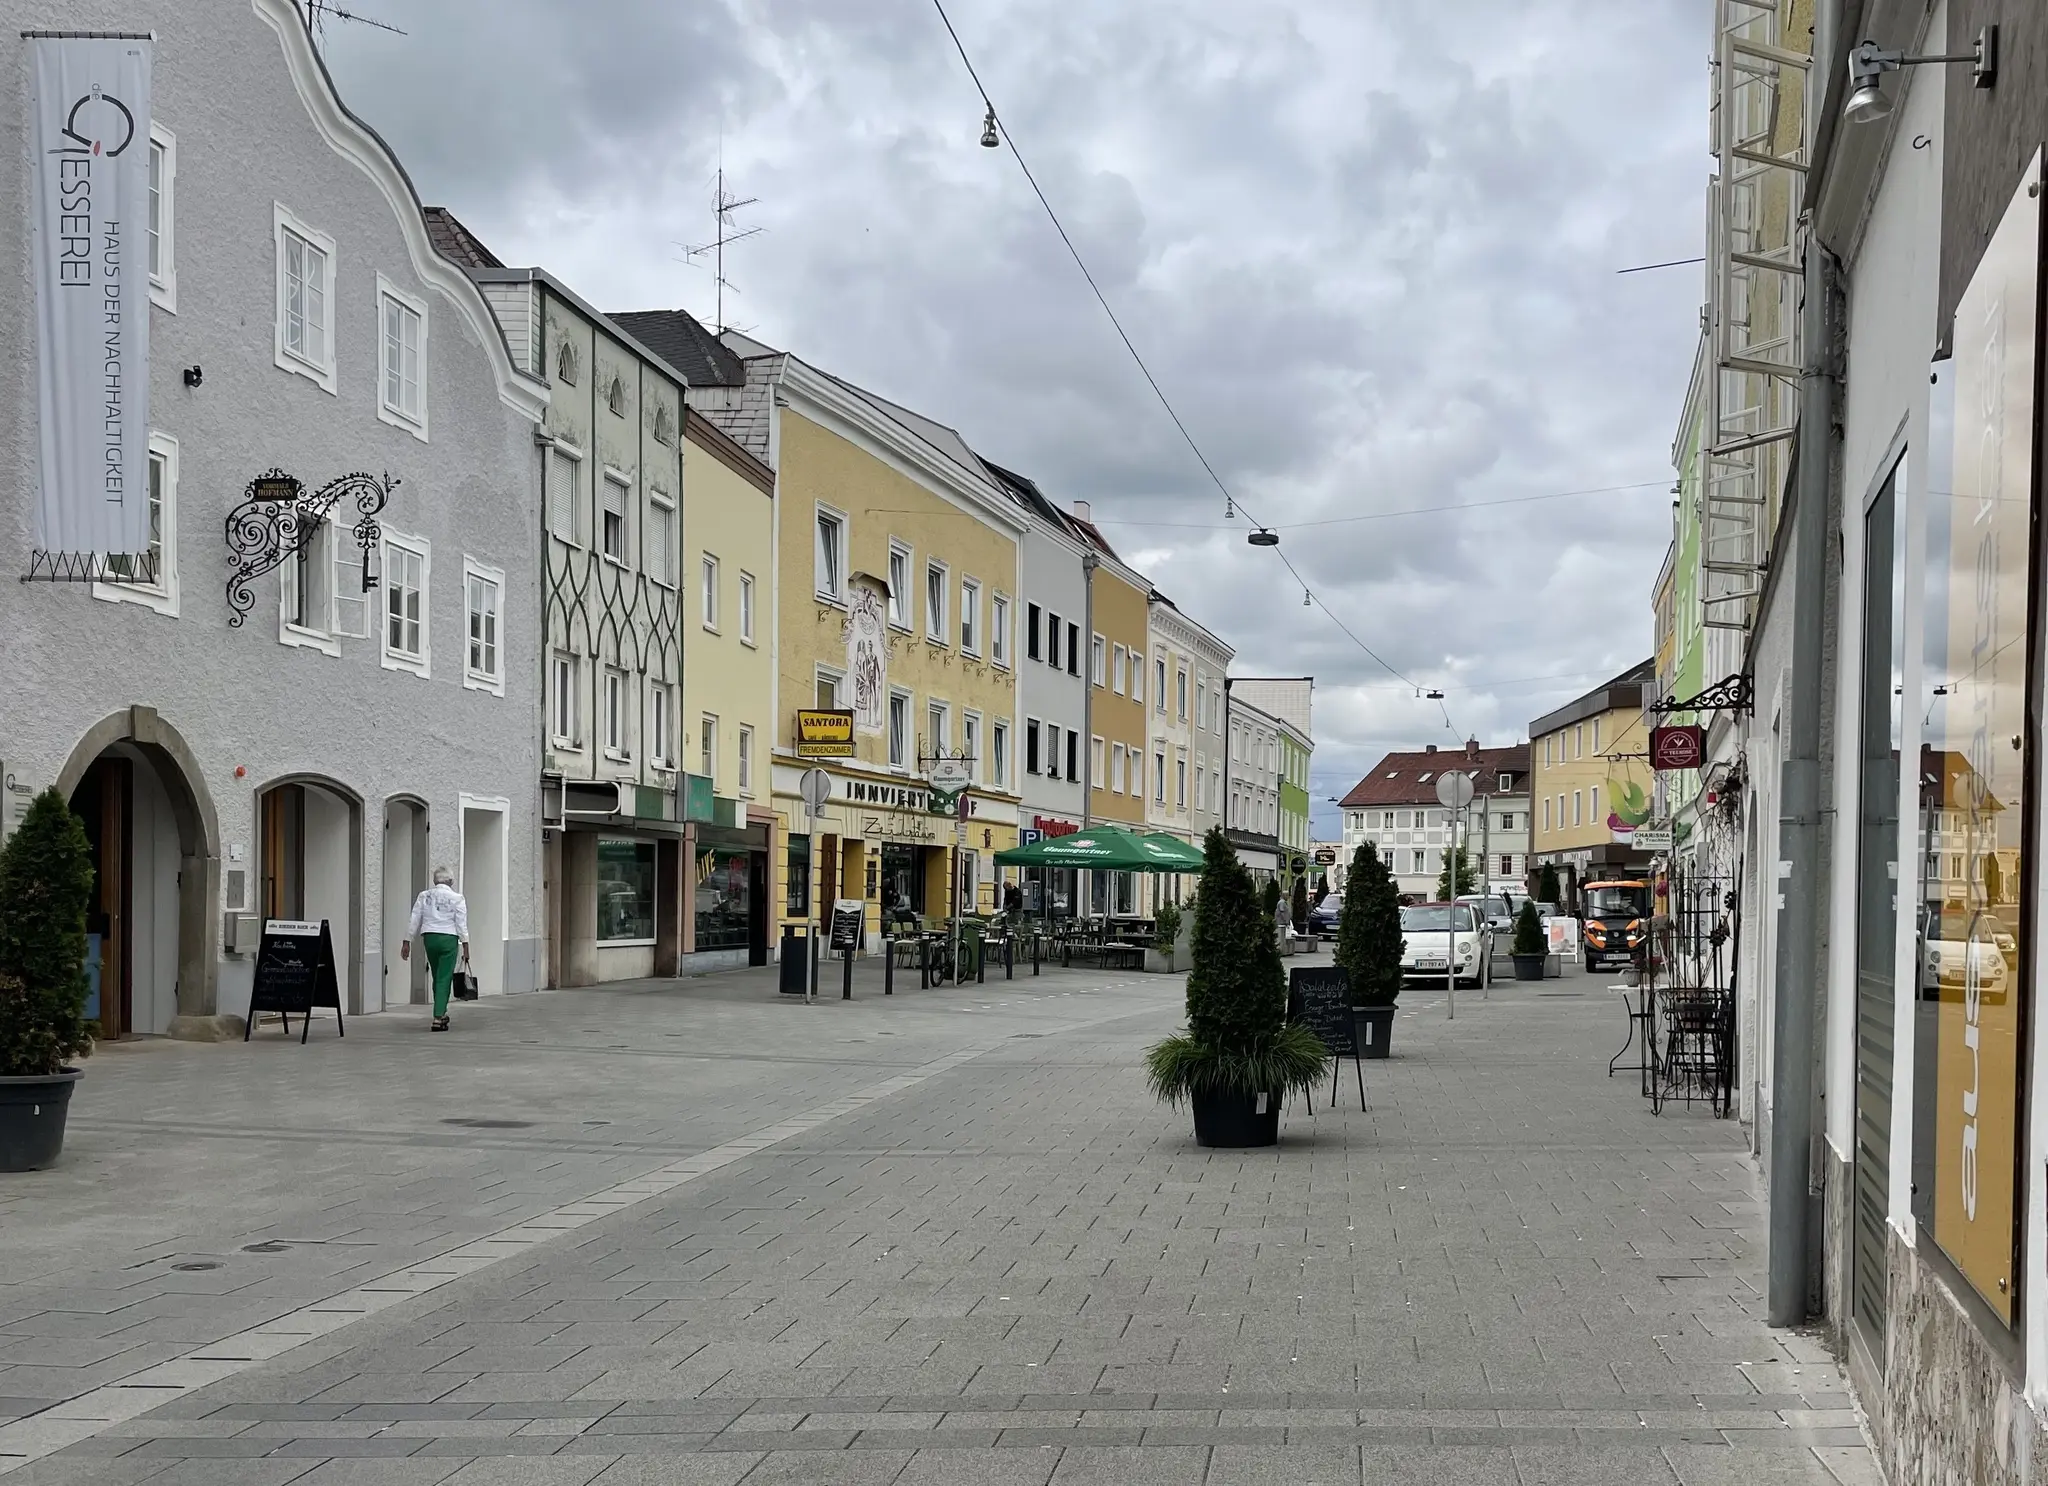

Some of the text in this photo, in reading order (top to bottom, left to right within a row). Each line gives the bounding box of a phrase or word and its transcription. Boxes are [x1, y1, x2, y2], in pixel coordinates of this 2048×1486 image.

[103, 220, 124, 508] HAUS DER NACHHALTIGKEIT
[257, 488, 294, 497] HOFMANN
[803, 717, 850, 727] SANTORA
[799, 745, 852, 755] FREMDENZIMMER
[1042, 846, 1114, 855] Baumgartner
[695, 848, 717, 885] LIVE
